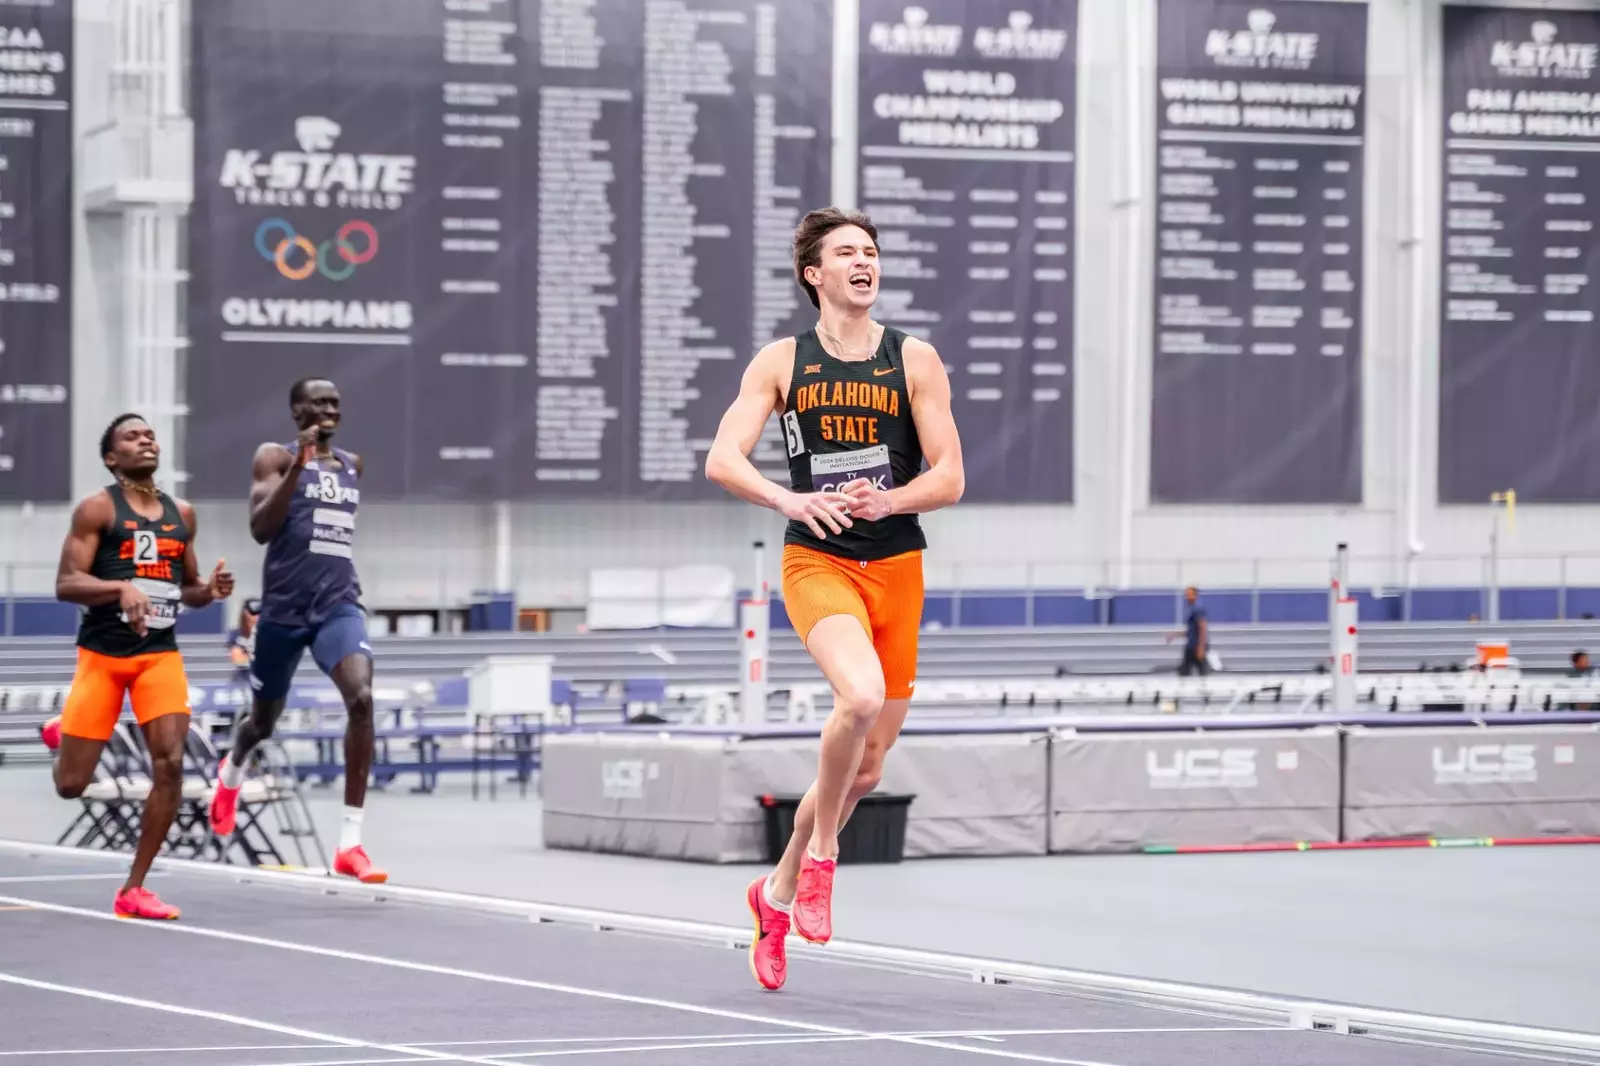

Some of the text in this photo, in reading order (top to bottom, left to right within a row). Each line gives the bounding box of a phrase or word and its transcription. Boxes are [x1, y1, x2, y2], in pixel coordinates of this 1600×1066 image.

[1205, 30, 1319, 59] K-STATE
[1489, 40, 1599, 69] K-STATE
[923, 68, 1016, 95] WORLD
[1160, 78, 1362, 105] WORLD UNIVERSITY
[873, 93, 1064, 123] CHAMPIONSHIP
[1466, 88, 1512, 111] PAN
[1166, 102, 1355, 130] GAMES MEDALISTS
[1449, 111, 1522, 135] GAMES
[898, 120, 1039, 149] MEDALISTS
[219, 149, 417, 193] K-STATE
[234, 187, 307, 206] TRACK
[336, 190, 403, 211] FIELD
[221, 297, 413, 329] OLYMPIANS
[797, 381, 899, 417] OKLAHOMA
[786, 415, 798, 455] 5
[820, 415, 879, 444] STATE
[829, 459, 872, 469] INVITATIONAL
[834, 455, 858, 464] DELOSS
[324, 475, 336, 500] 3
[846, 472, 858, 480] TY
[138, 534, 153, 561] 2
[1146, 749, 1258, 777] UCS
[1433, 744, 1537, 772] UCS
